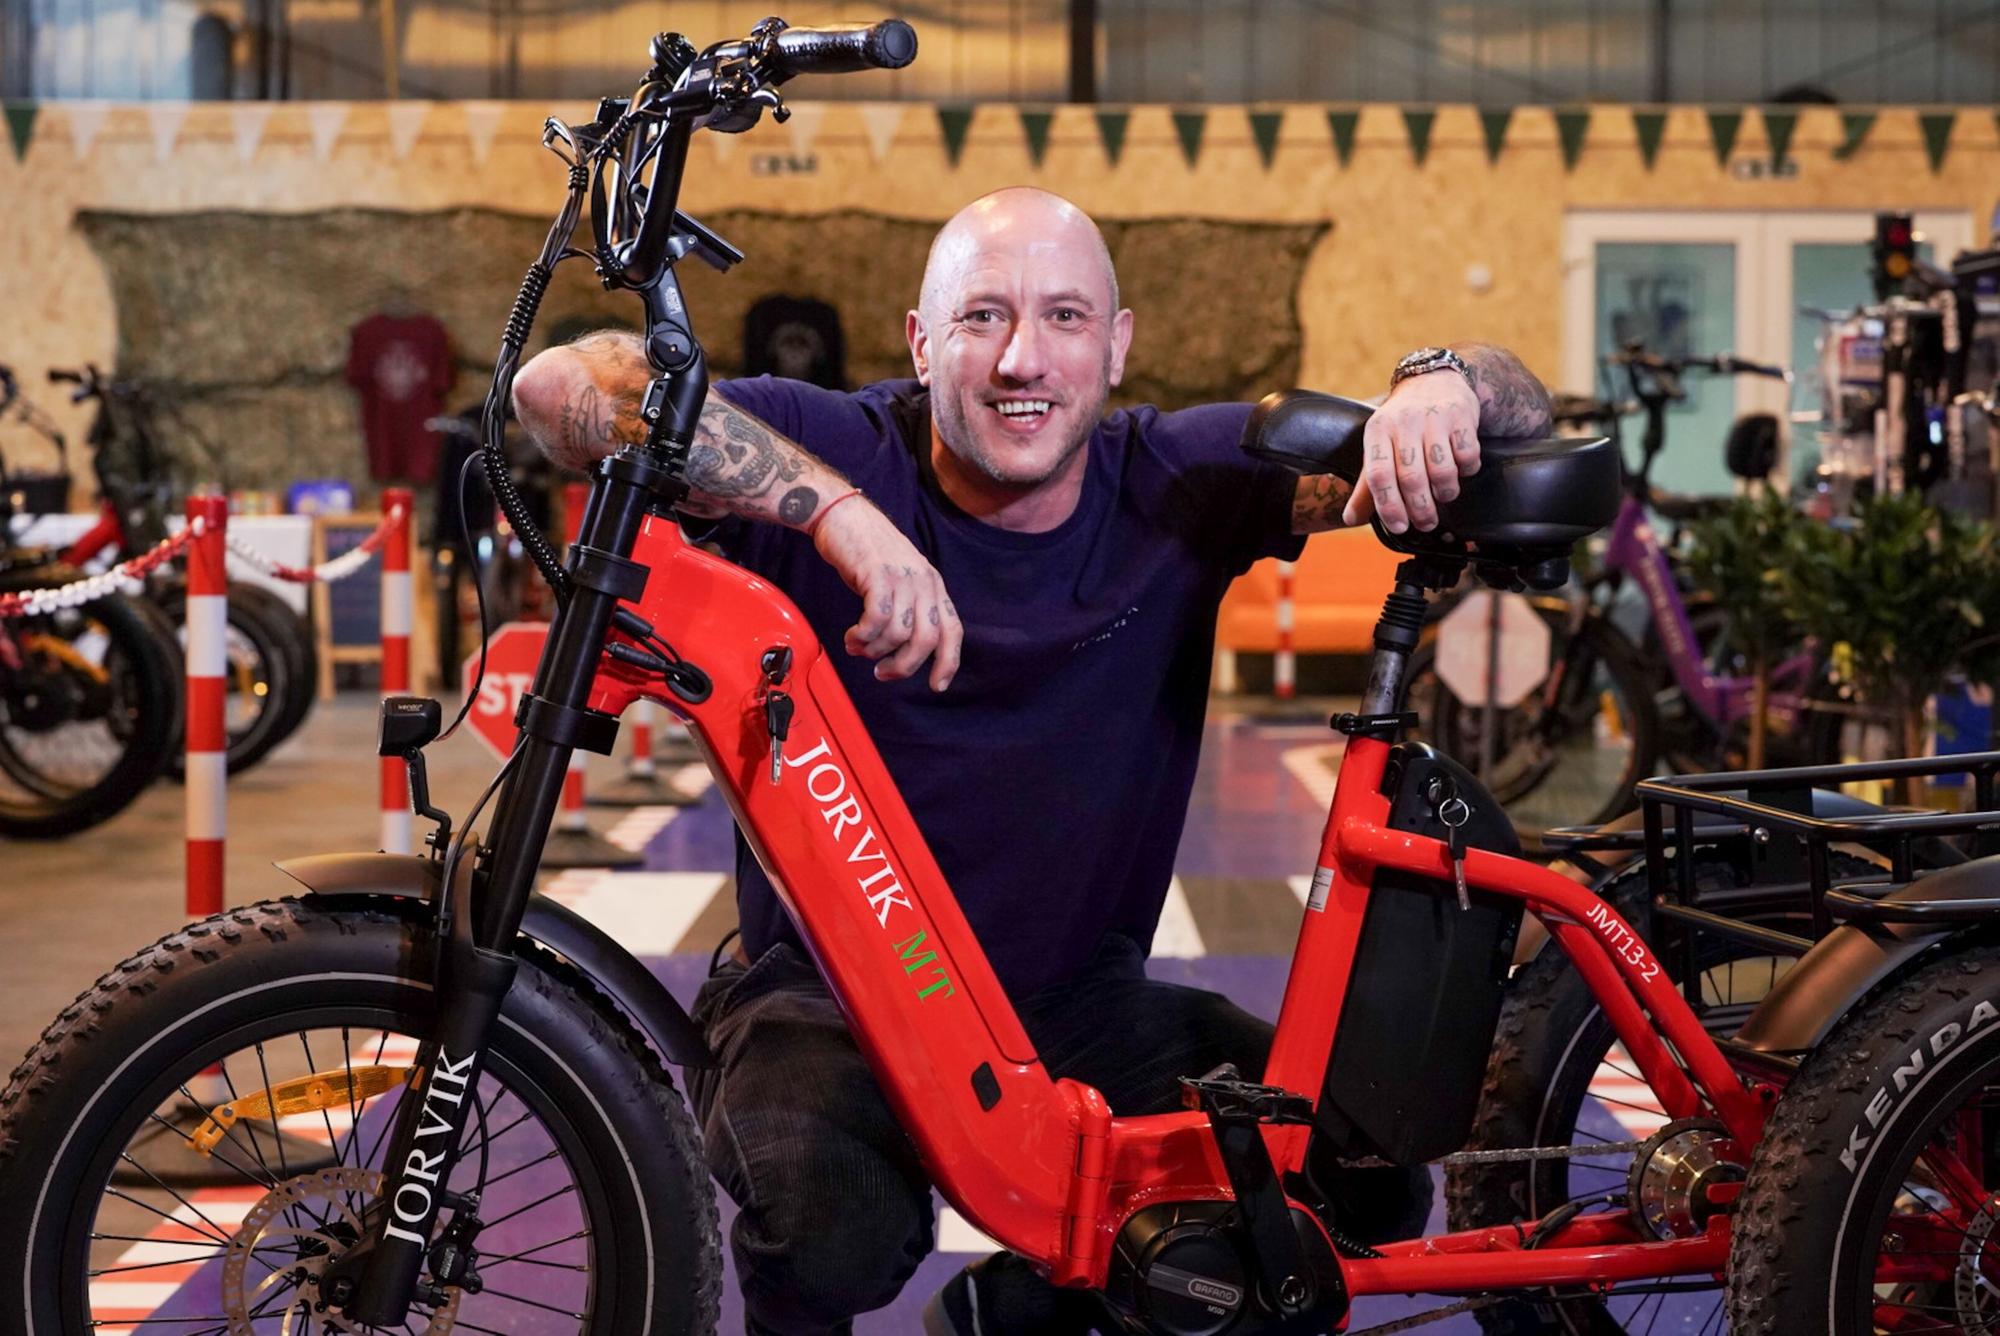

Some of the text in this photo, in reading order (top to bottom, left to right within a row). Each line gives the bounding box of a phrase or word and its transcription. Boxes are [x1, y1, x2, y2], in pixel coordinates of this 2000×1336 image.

[478, 672, 534, 717] ST
[783, 736, 955, 1002] JORVIK MT
[1586, 903, 1659, 983] JMT13-2
[382, 1044, 477, 1251] JORVIK
[1838, 1000, 2000, 1174] KENDA
